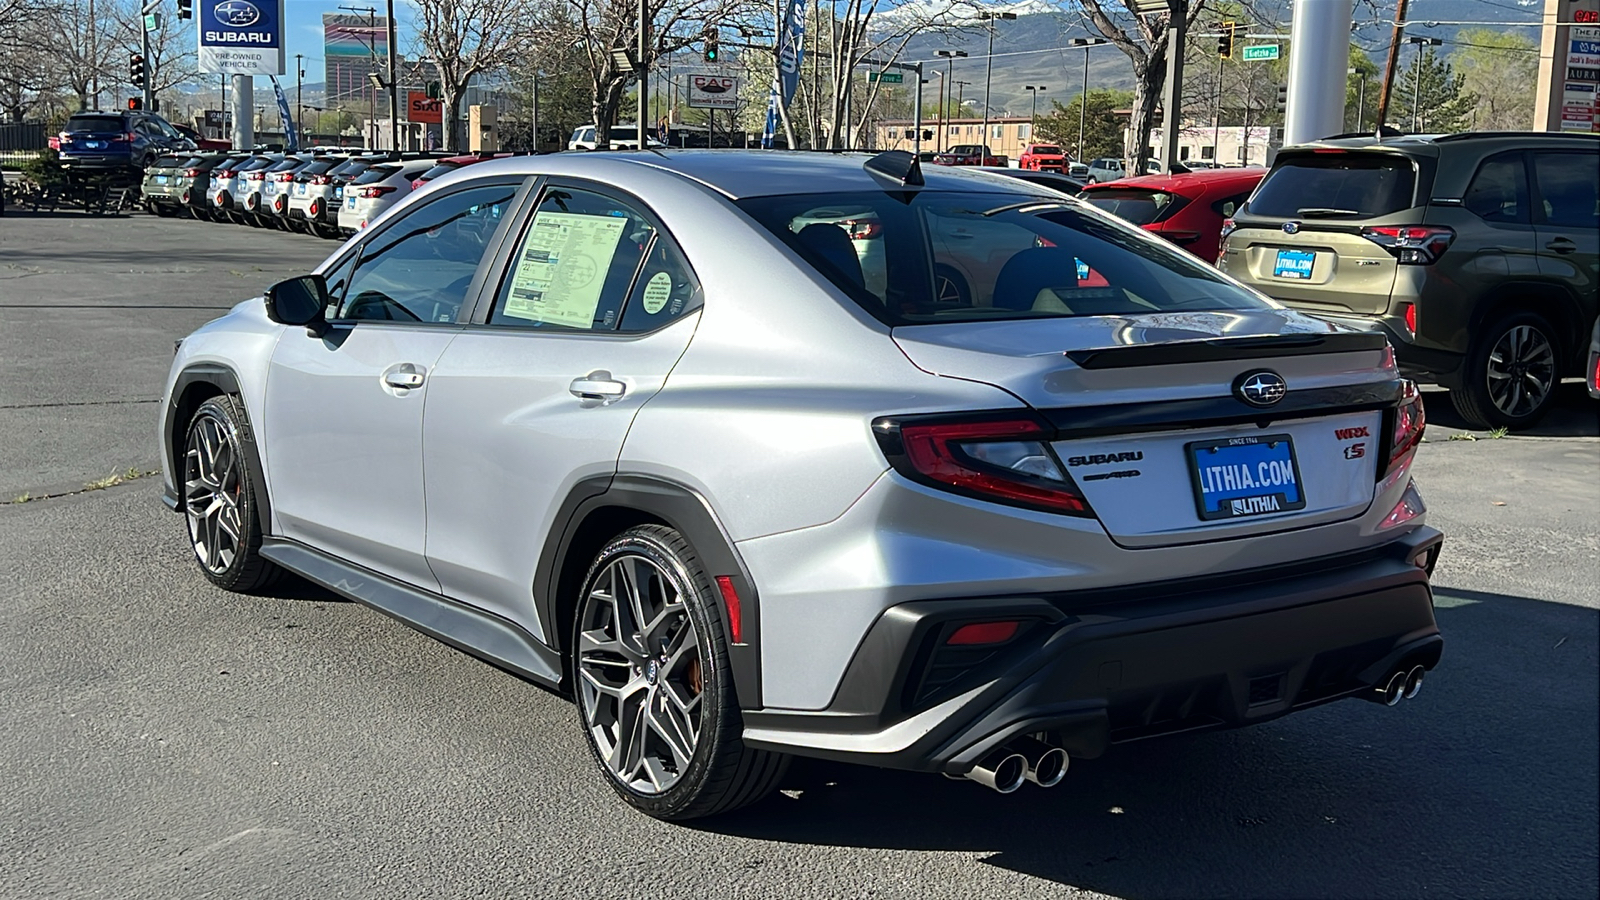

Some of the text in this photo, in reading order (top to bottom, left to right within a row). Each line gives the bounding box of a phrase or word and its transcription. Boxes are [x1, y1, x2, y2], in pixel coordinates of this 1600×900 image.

[205, 31, 271, 43] SUBARU
[1570, 69, 1596, 79] AURA
[694, 77, 733, 88] CAC
[1276, 258, 1313, 271] LITHIA.COM
[1334, 426, 1370, 440] WRX
[1228, 438, 1245, 446] SINCE
[1068, 450, 1143, 467] SUBARU
[1198, 459, 1296, 494] LITHIA.COM
[1242, 495, 1280, 514] LITHIA
